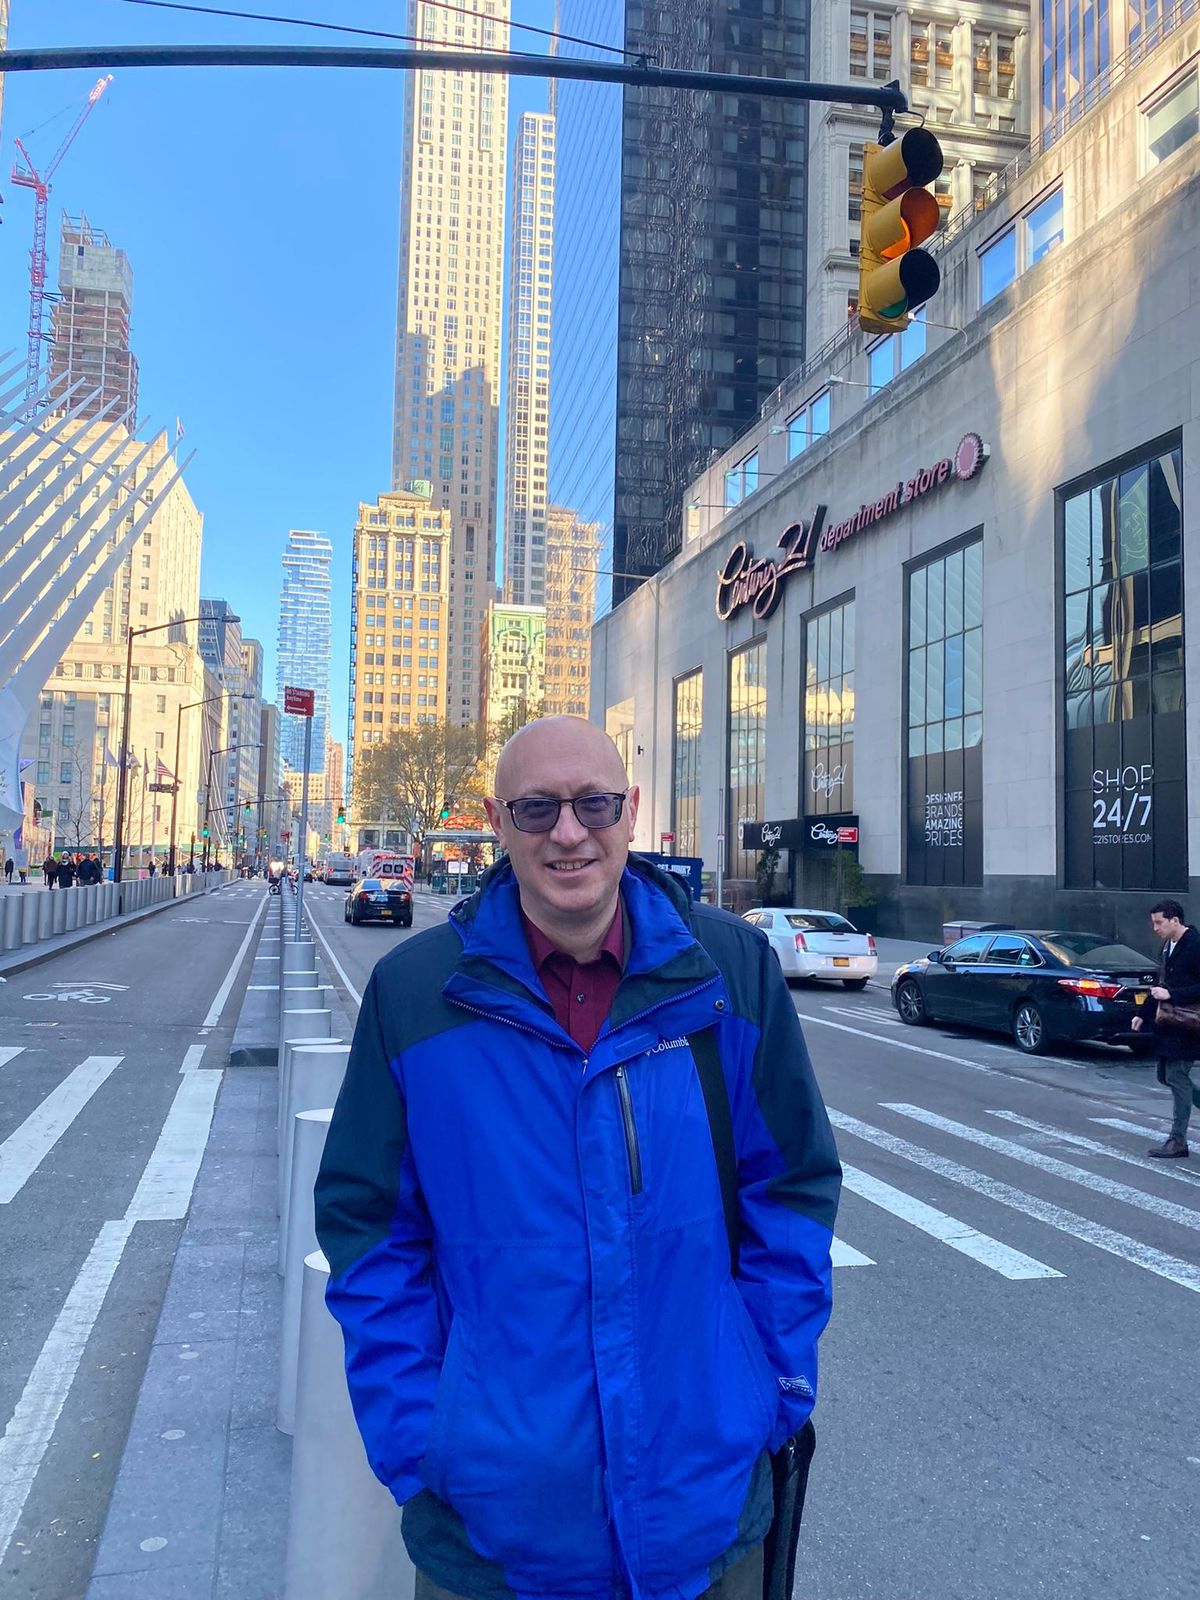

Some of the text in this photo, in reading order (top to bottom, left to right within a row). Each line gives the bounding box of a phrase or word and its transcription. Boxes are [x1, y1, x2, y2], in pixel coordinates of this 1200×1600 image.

[716, 458, 952, 621] Century 21 department store
[1092, 764, 1154, 794] SHOP
[925, 803, 963, 819] BRANDS
[1093, 792, 1152, 832] 24/7
[925, 817, 963, 831] AMAZING
[925, 829, 963, 847] PRICES
